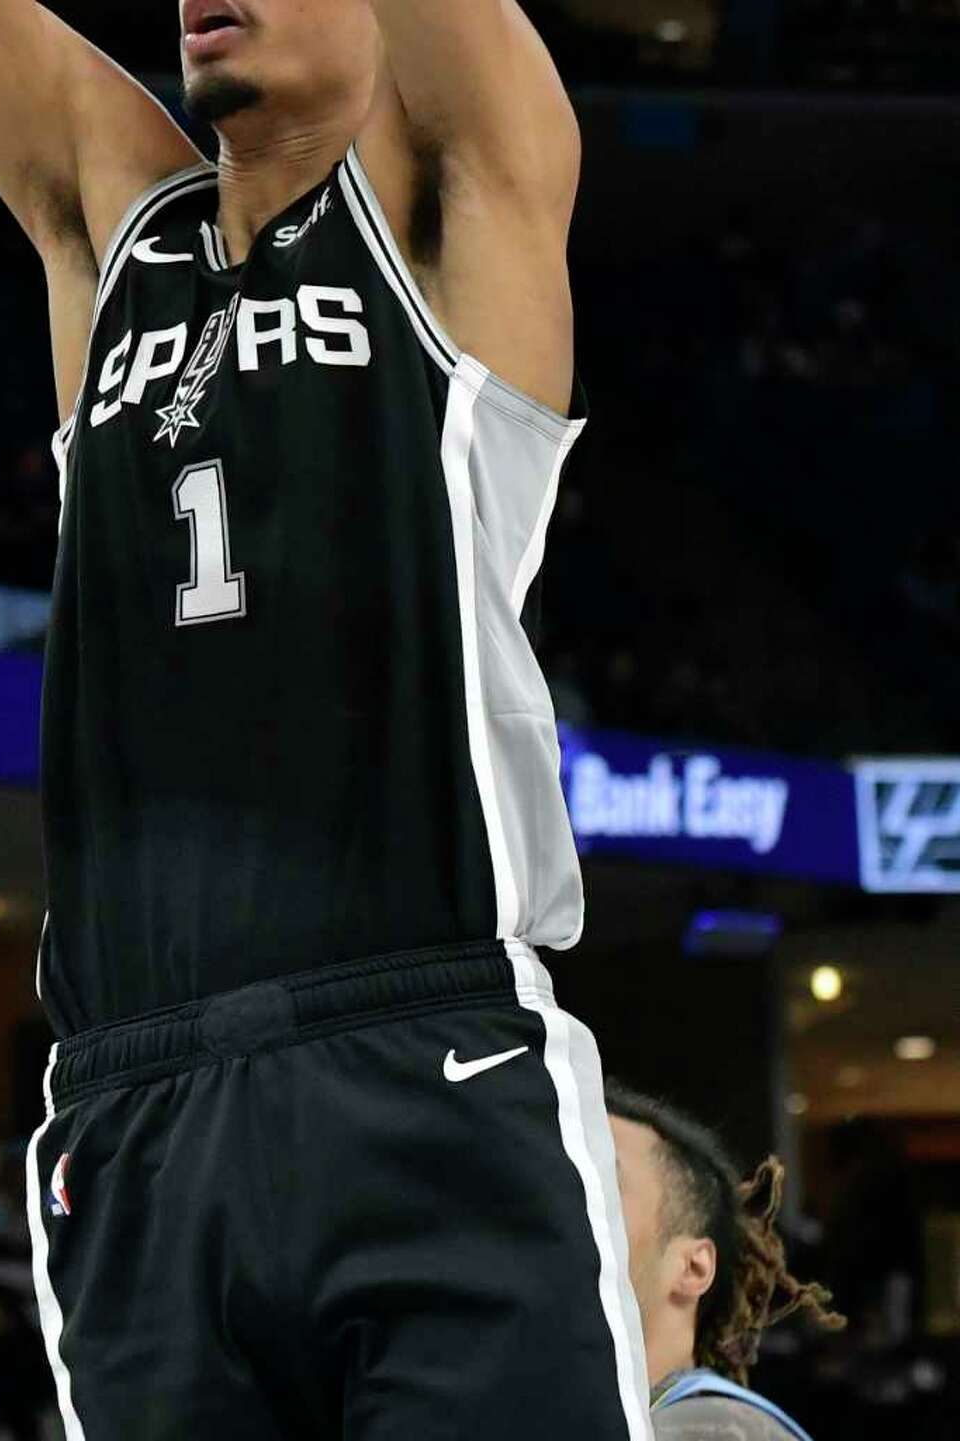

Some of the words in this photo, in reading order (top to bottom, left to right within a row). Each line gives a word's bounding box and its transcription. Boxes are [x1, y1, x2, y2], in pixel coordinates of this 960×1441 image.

[171, 458, 246, 627] 1
[571, 753, 681, 837] Bank
[684, 754, 788, 854] Easy
